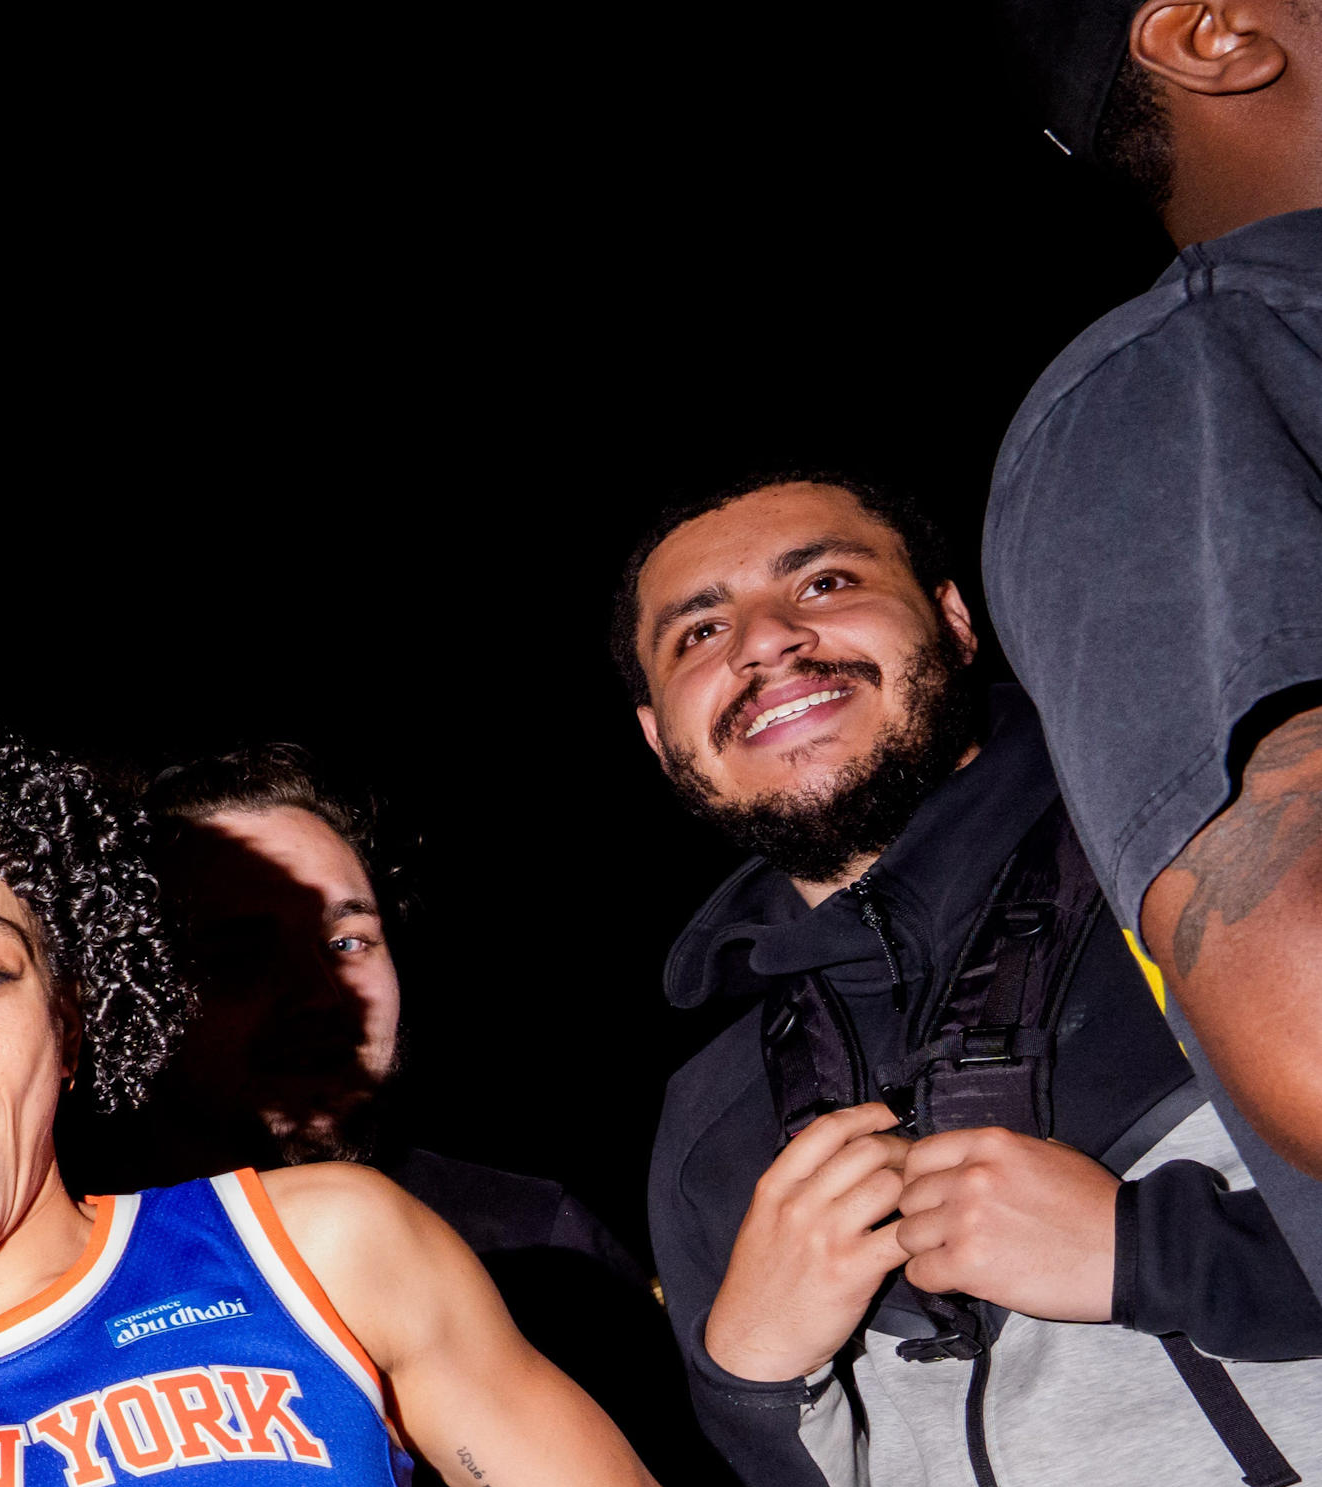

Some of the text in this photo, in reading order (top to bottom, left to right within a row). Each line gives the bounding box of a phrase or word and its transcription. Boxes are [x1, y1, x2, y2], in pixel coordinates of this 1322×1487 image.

[113, 1300, 181, 1328] experience
[116, 1298, 247, 1343] abu dhabi
